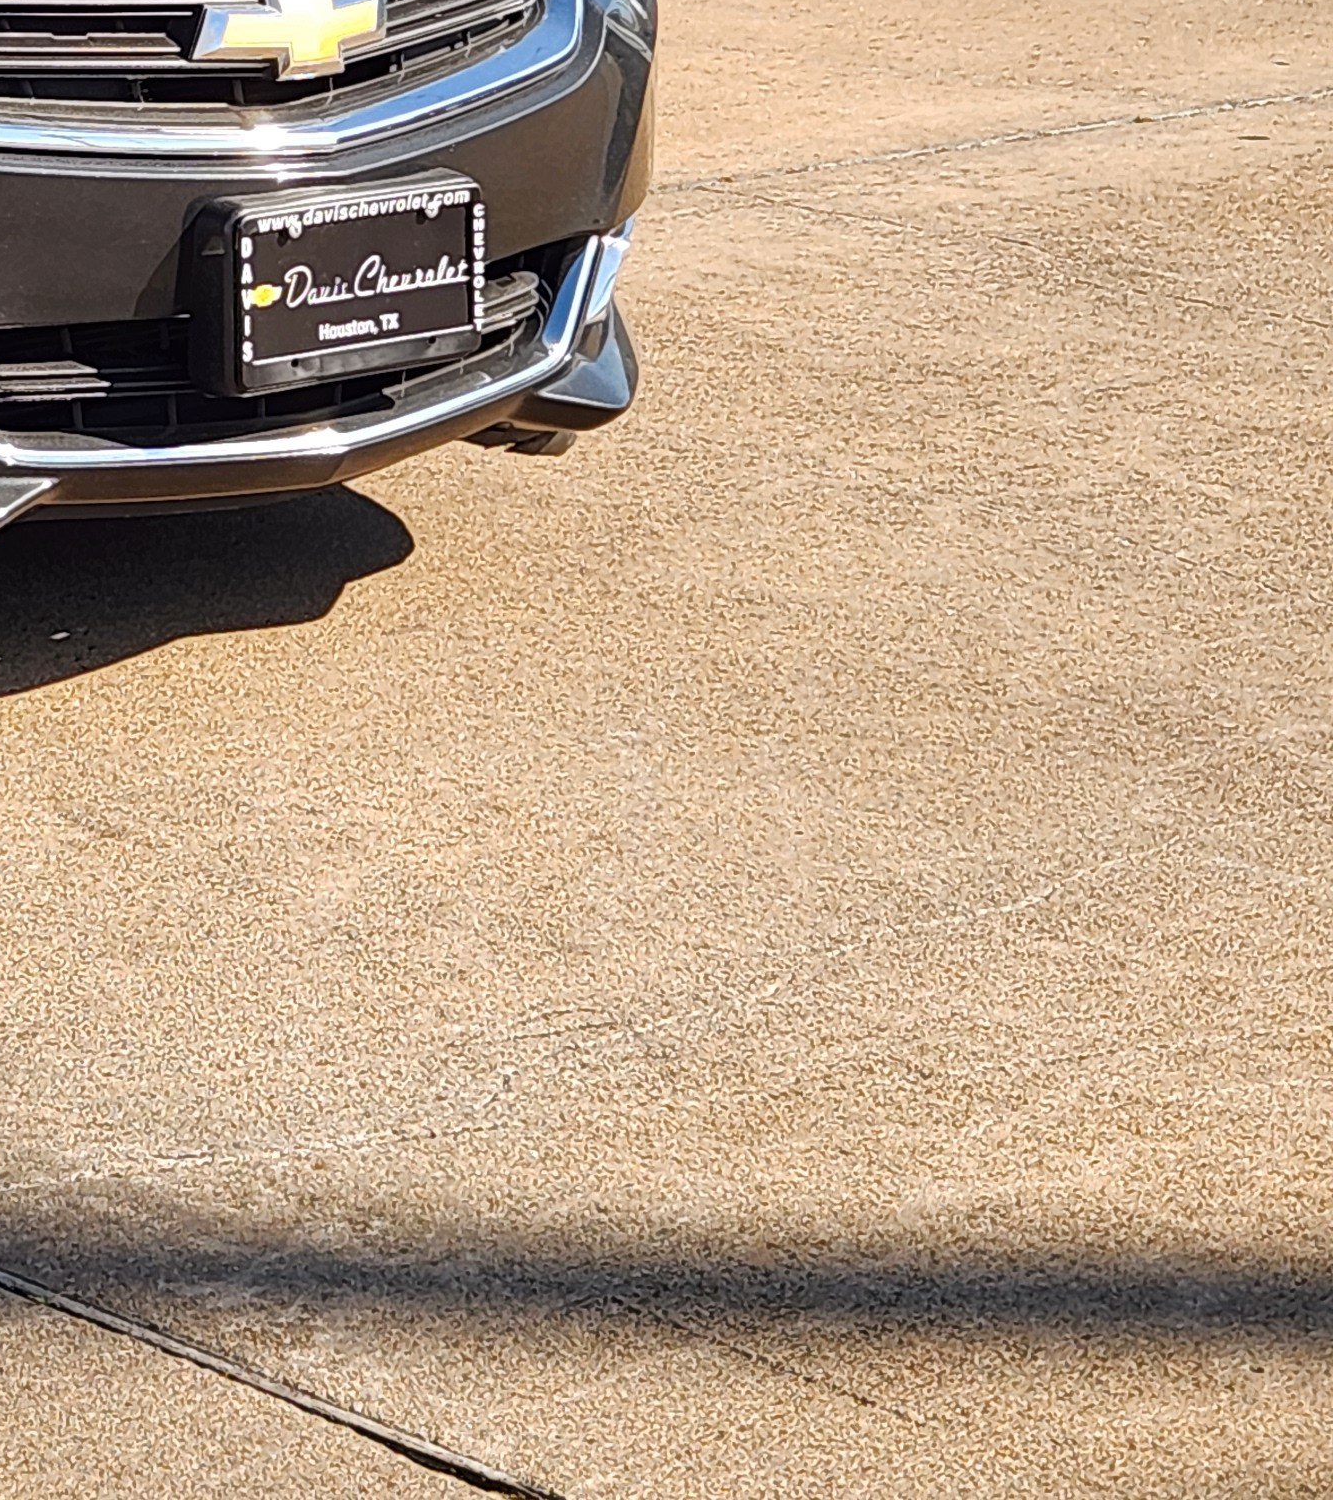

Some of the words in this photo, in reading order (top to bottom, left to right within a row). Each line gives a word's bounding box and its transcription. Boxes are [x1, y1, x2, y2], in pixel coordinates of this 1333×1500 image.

[241, 236, 253, 363] DAVIS
[284, 265, 355, 308] Davis
[353, 254, 471, 297] Chevrolet
[472, 203, 485, 332] CHEVROLET
[318, 317, 379, 341] Houston,
[379, 312, 400, 332] TX
